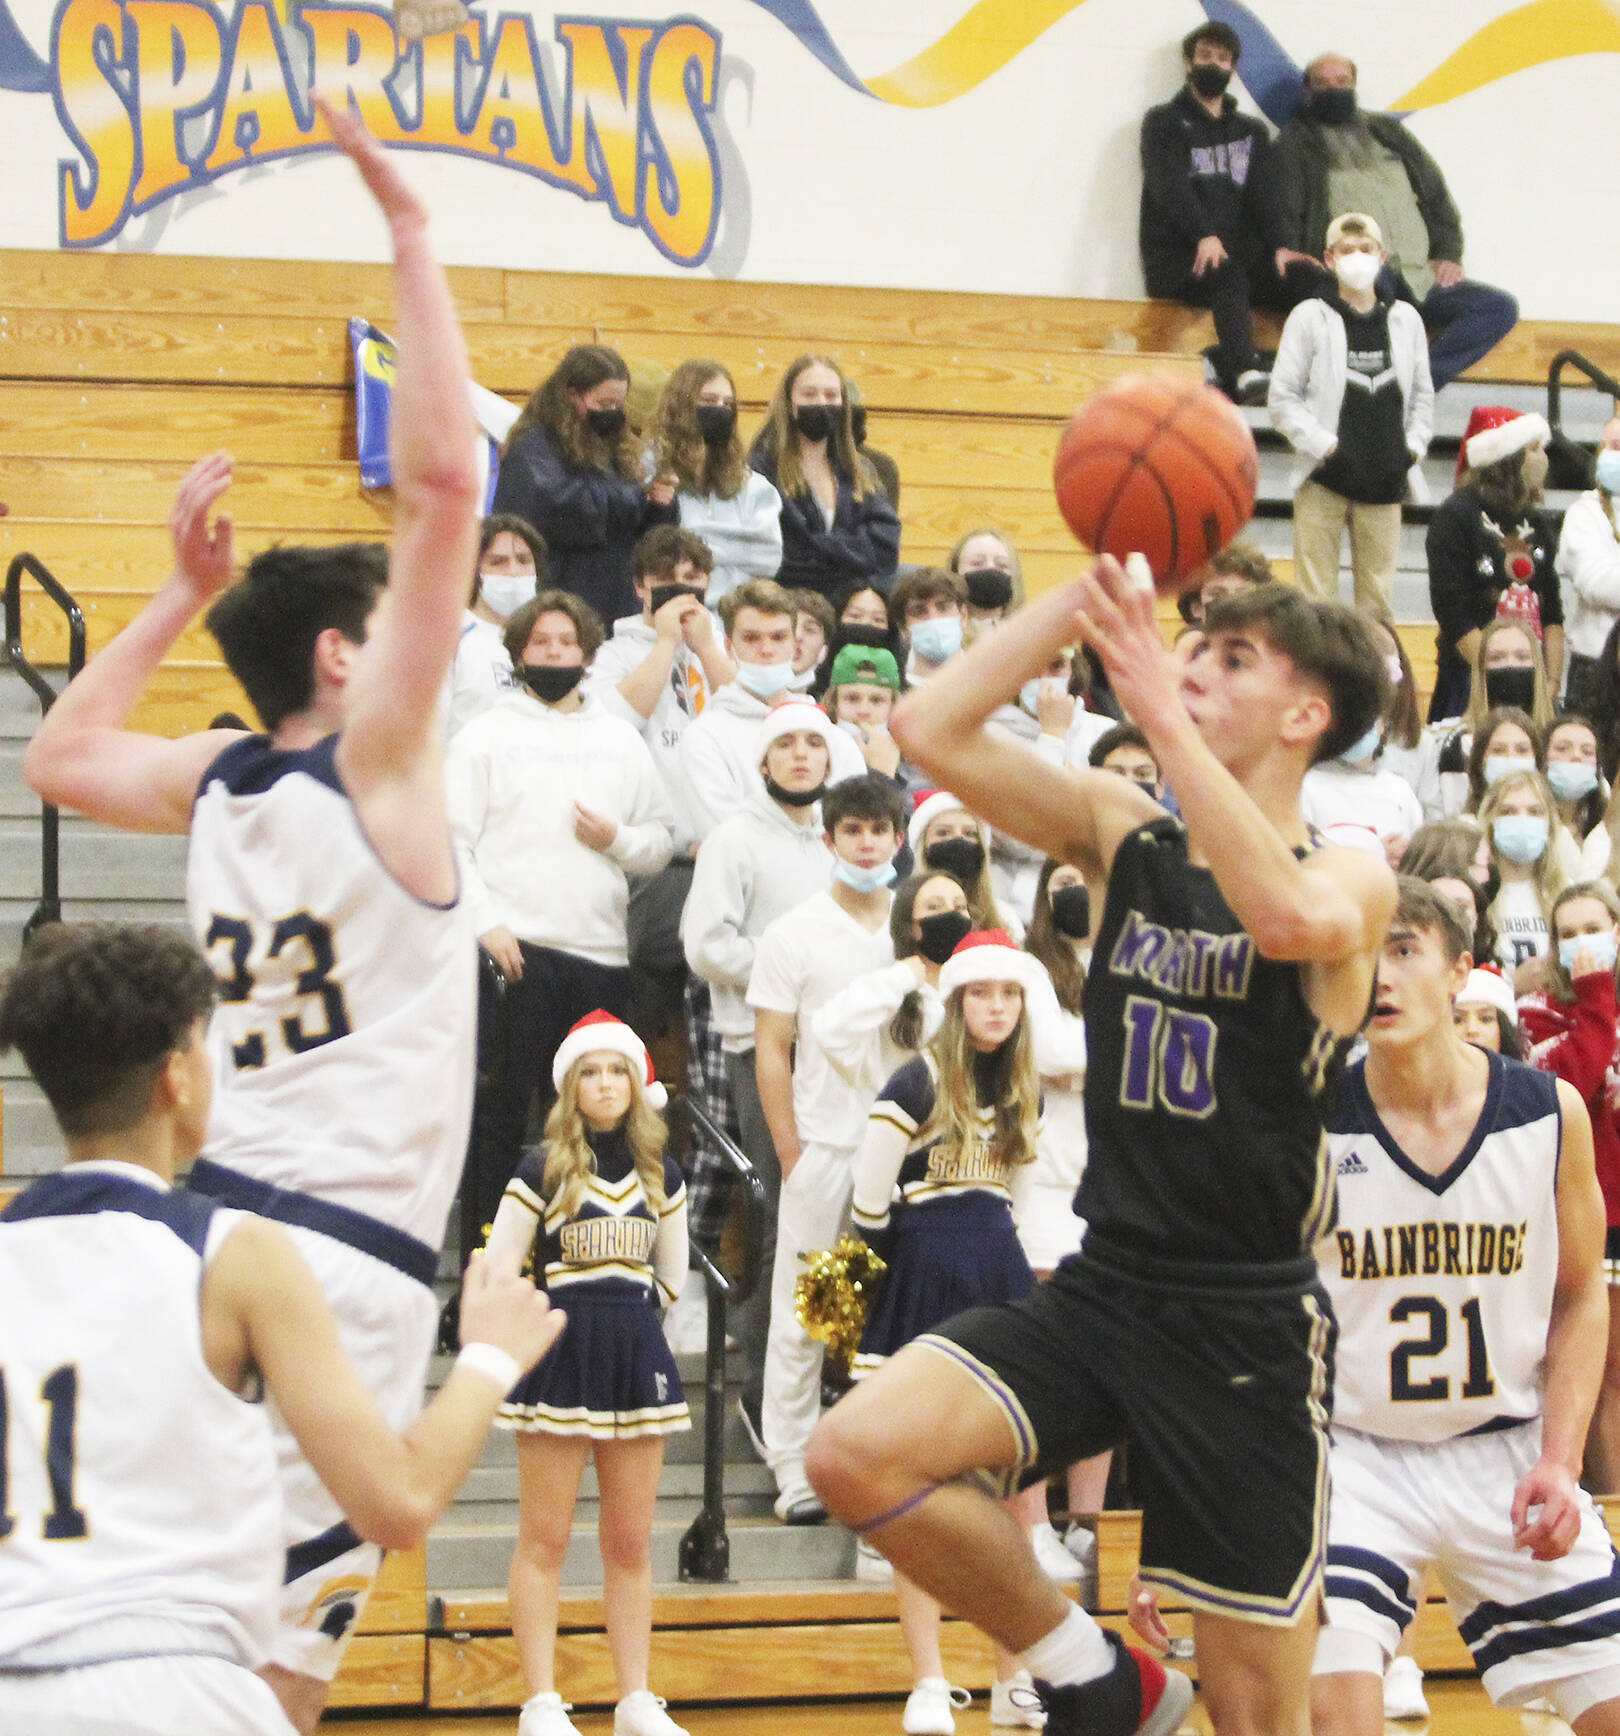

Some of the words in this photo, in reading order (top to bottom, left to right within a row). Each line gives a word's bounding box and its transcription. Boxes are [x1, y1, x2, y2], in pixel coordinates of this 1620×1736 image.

[52, 0, 723, 268] SPARTANS
[1120, 994, 1218, 1119] 10
[1389, 1294, 1496, 1403] 21
